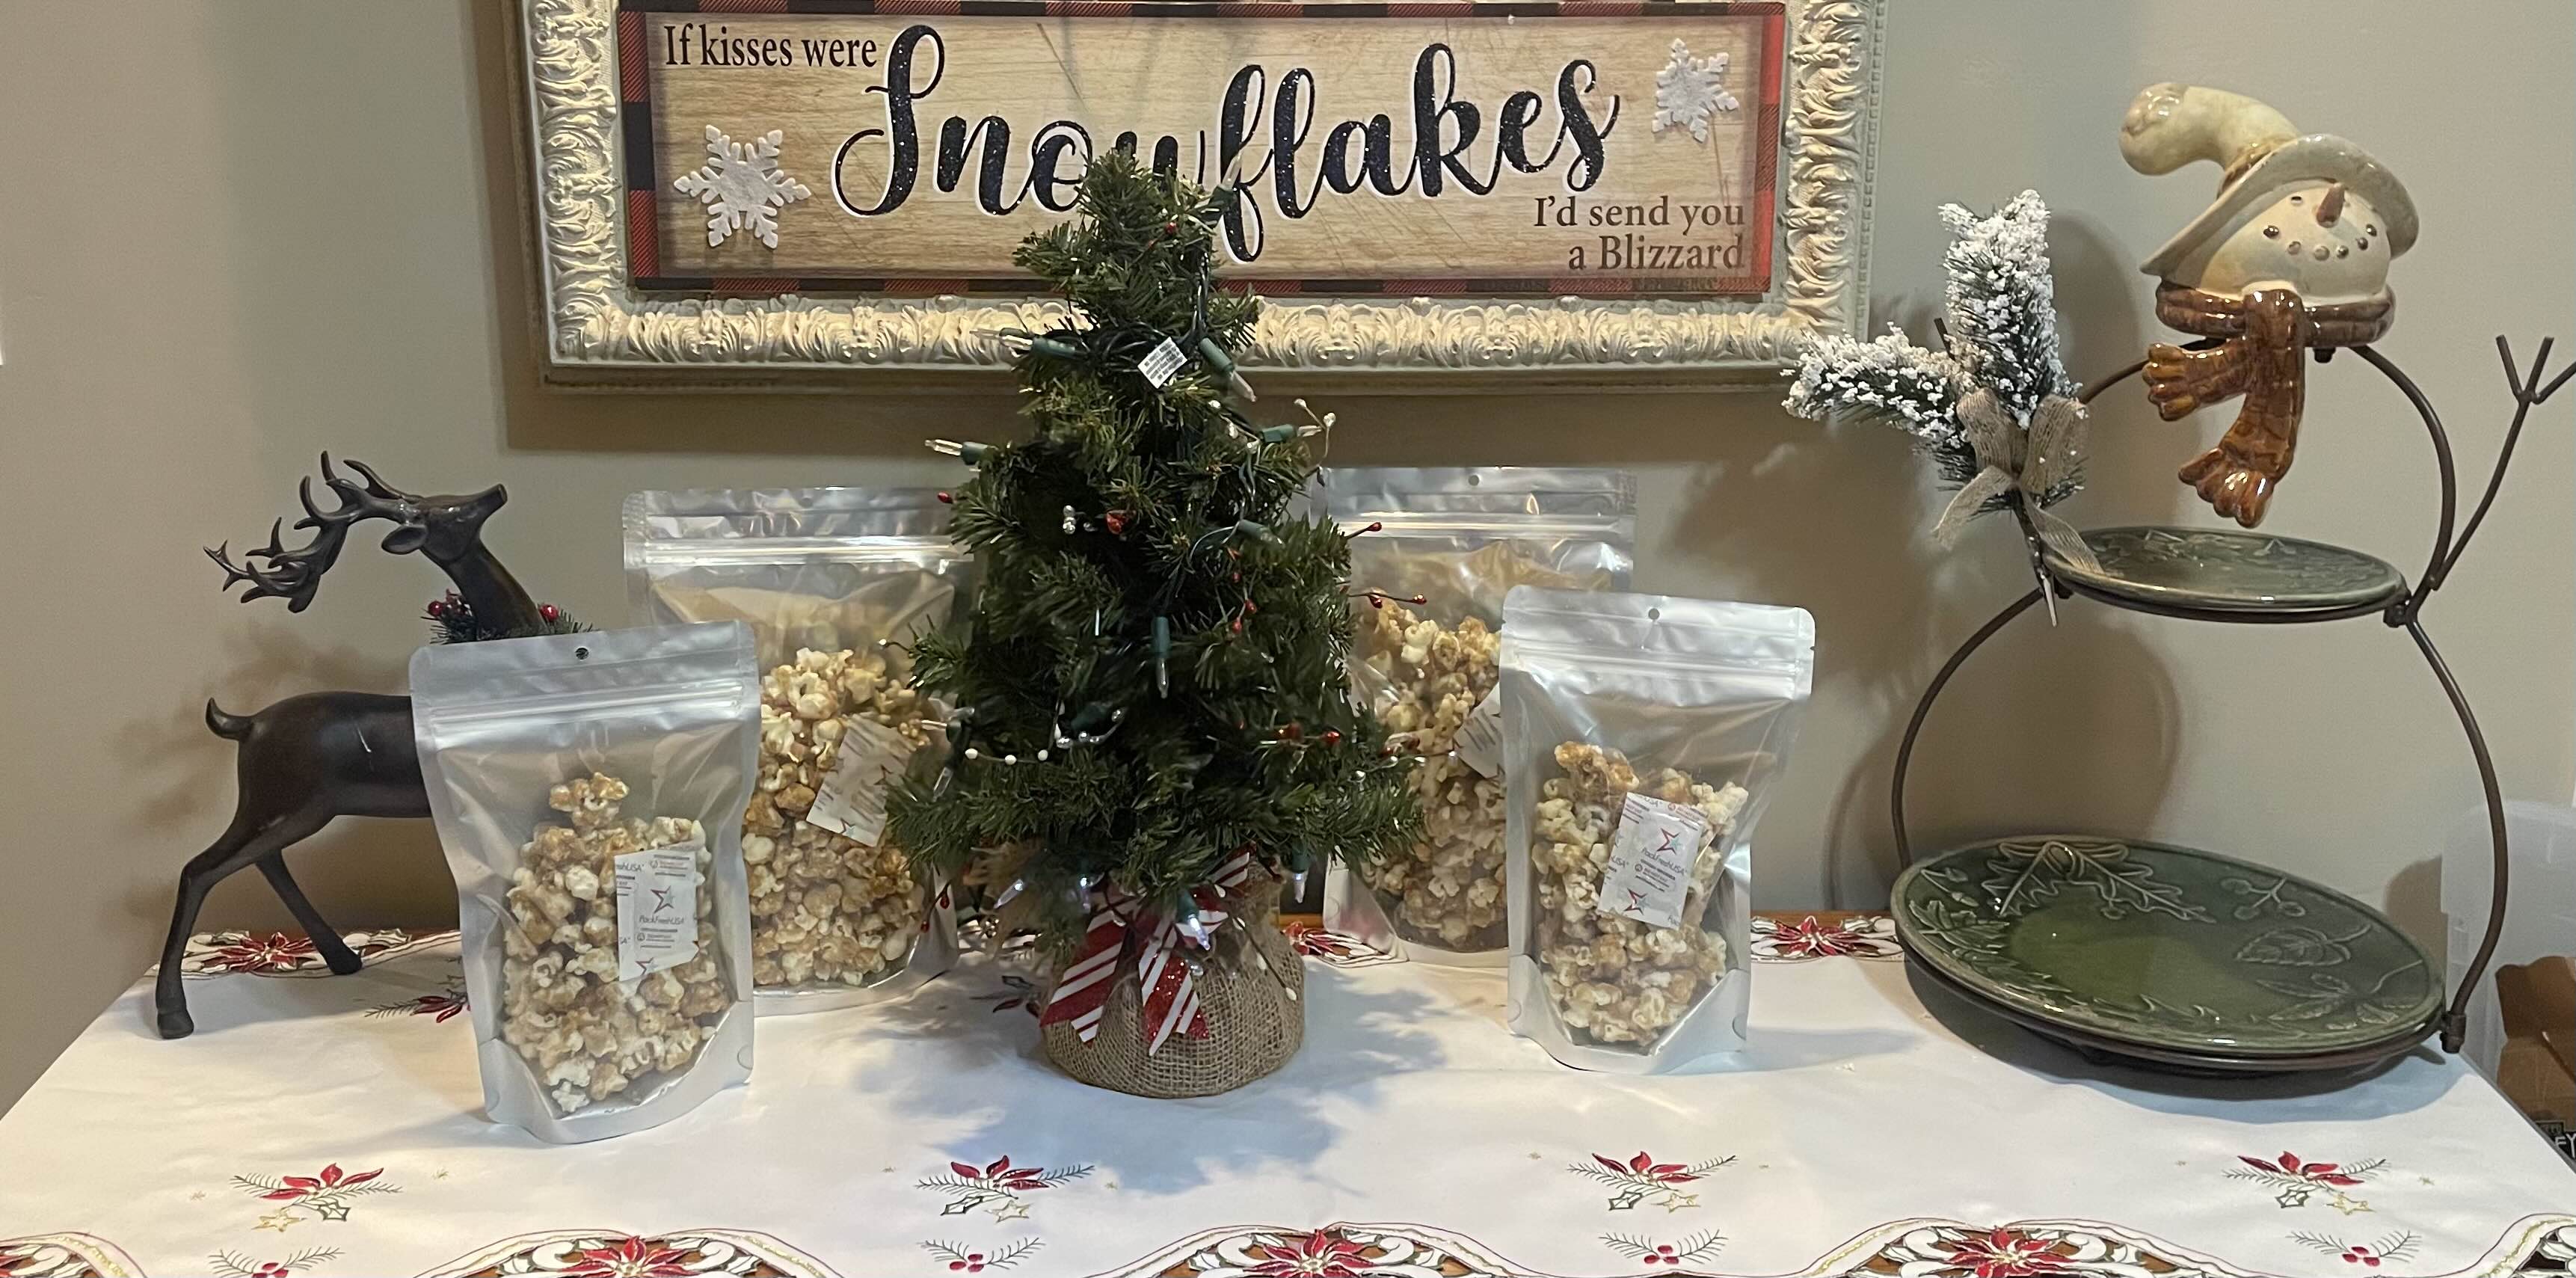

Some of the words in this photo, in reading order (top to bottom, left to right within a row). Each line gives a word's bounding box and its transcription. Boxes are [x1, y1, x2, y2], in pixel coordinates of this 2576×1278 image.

[664, 22, 694, 65] If
[698, 24, 793, 67] kisses
[801, 38, 877, 67] were
[833, 24, 1620, 262] Snowflakes
[1534, 195, 1578, 227] I'd
[1588, 195, 1670, 227] send
[1680, 204, 1745, 236] you
[1568, 245, 1587, 270] a
[1597, 233, 1745, 271] Blizzard
